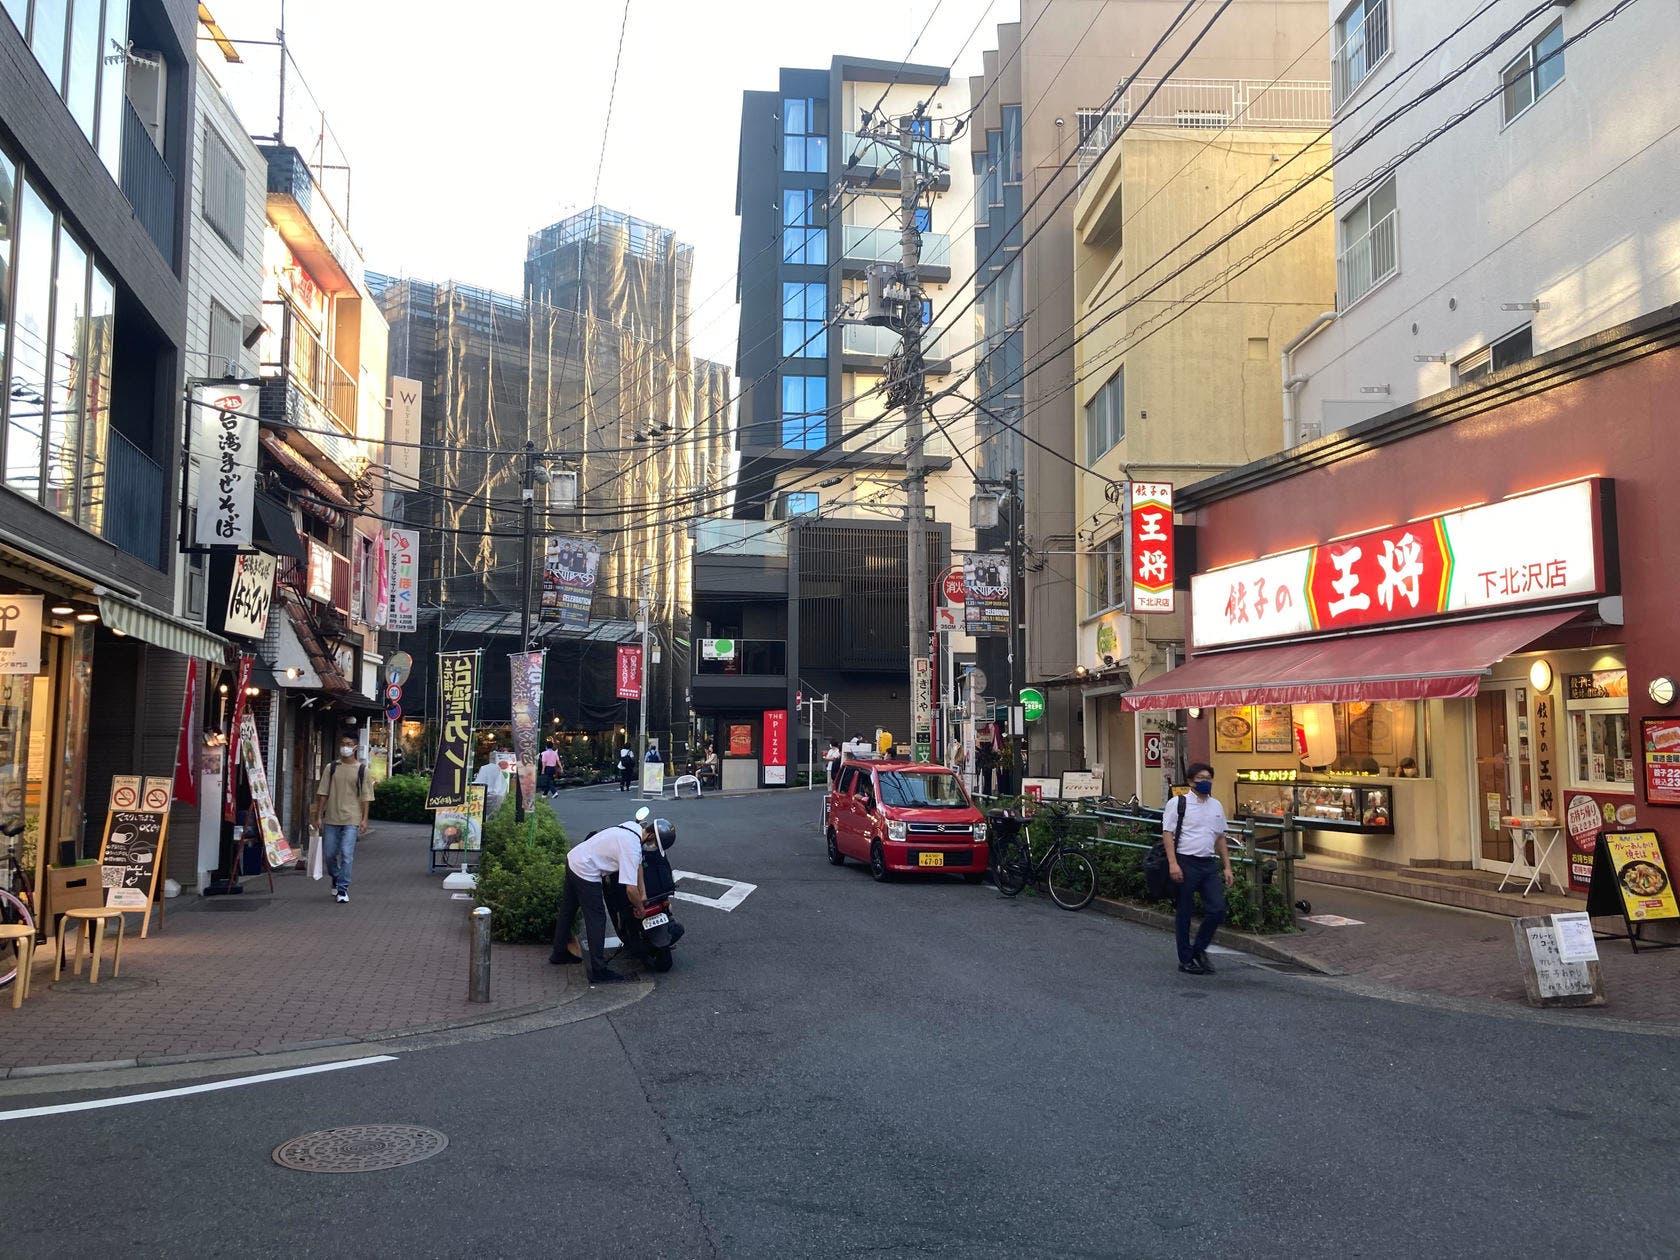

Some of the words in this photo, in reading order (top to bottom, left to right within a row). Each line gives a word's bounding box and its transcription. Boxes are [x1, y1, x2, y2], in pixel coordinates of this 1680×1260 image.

[215, 409, 242, 538] 台湾まぜそば
[1135, 485, 1169, 497] 餃子の
[1139, 512, 1168, 581] 王将
[946, 581, 964, 594] 消火
[1225, 577, 1293, 625] 餃子の
[1328, 532, 1424, 618] 王将
[1477, 559, 1567, 598] 下北沢店
[1137, 597, 1169, 608] 下北沢店
[390, 689, 398, 697] 30
[919, 679, 928, 711] きくや
[1537, 702, 1553, 811] 餃子の王将
